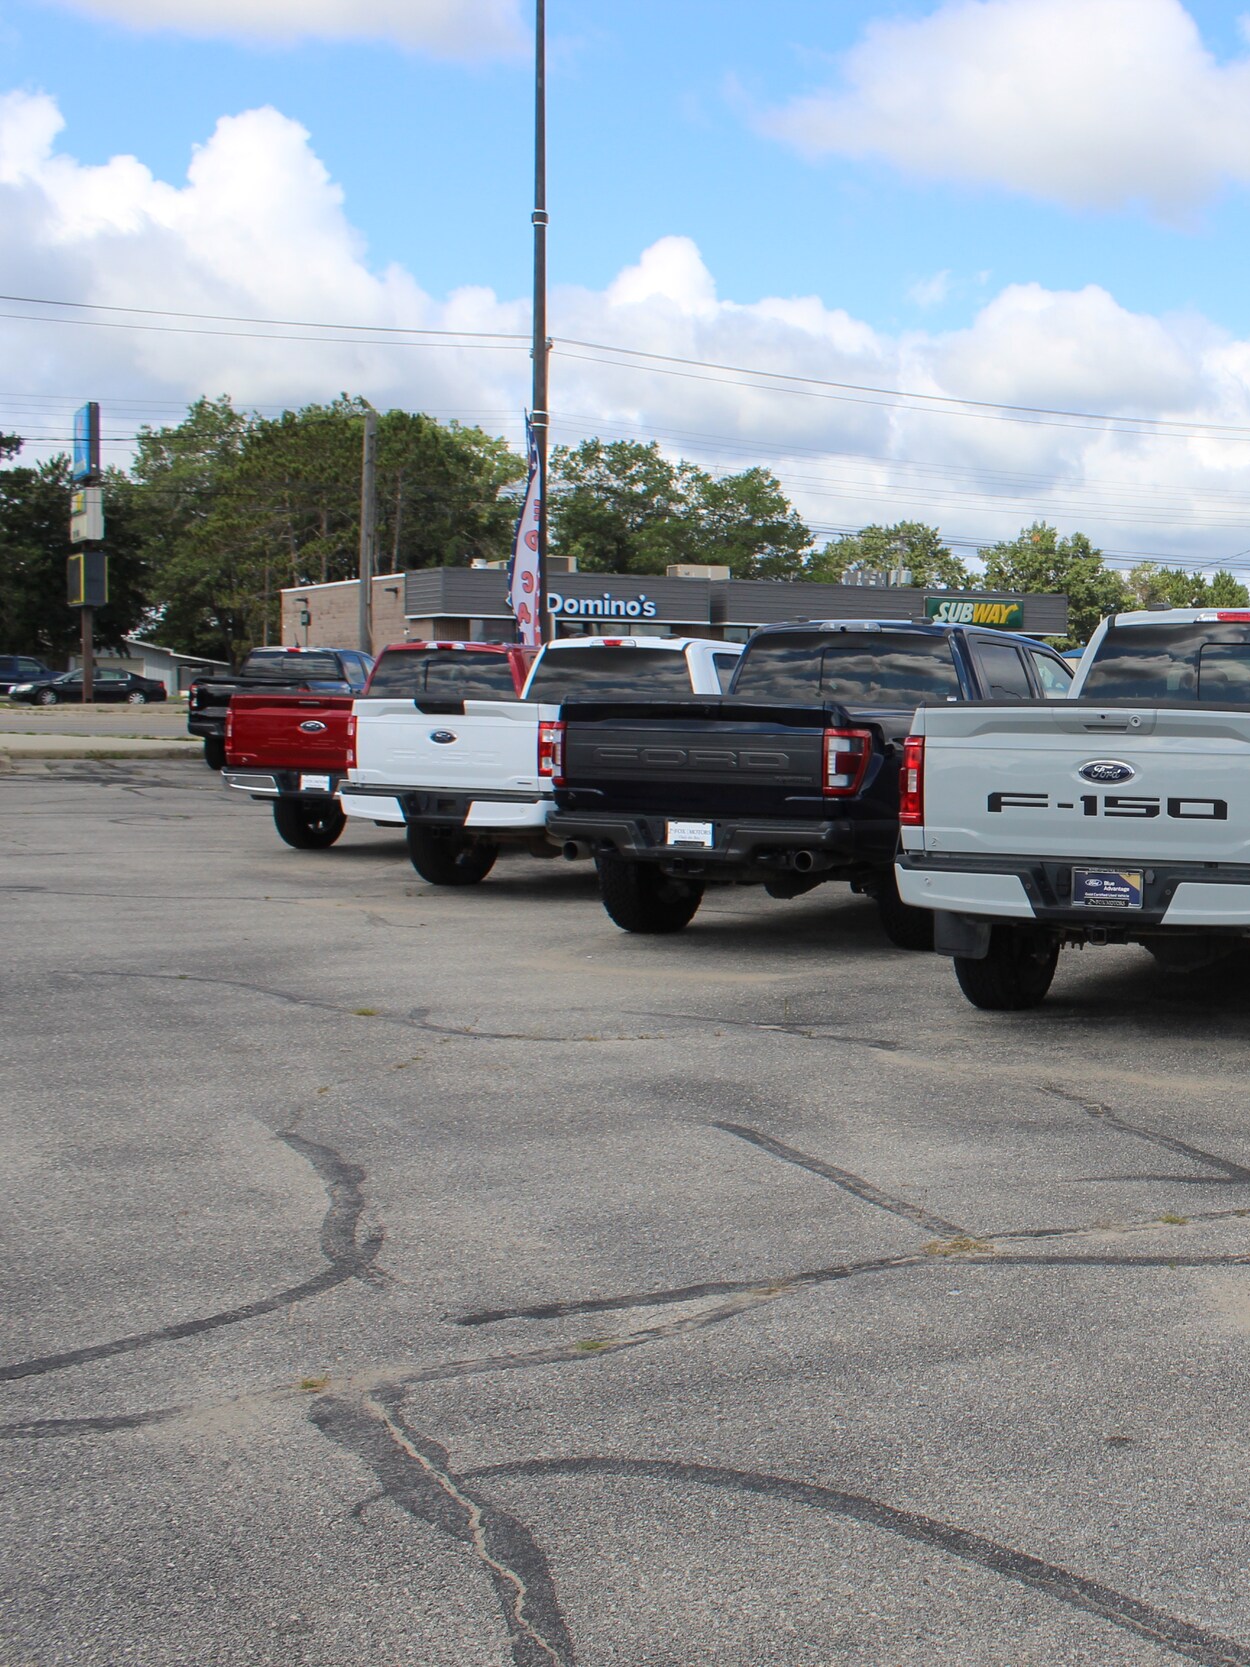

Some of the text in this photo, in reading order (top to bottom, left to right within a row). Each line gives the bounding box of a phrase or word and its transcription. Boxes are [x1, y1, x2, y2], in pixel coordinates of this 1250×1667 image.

[547, 592, 657, 617] Domino's
[932, 602, 1019, 624] SUBWAY
[593, 747, 790, 770] FORD
[1091, 765, 1121, 779] Ford
[987, 792, 1228, 820] F-150
